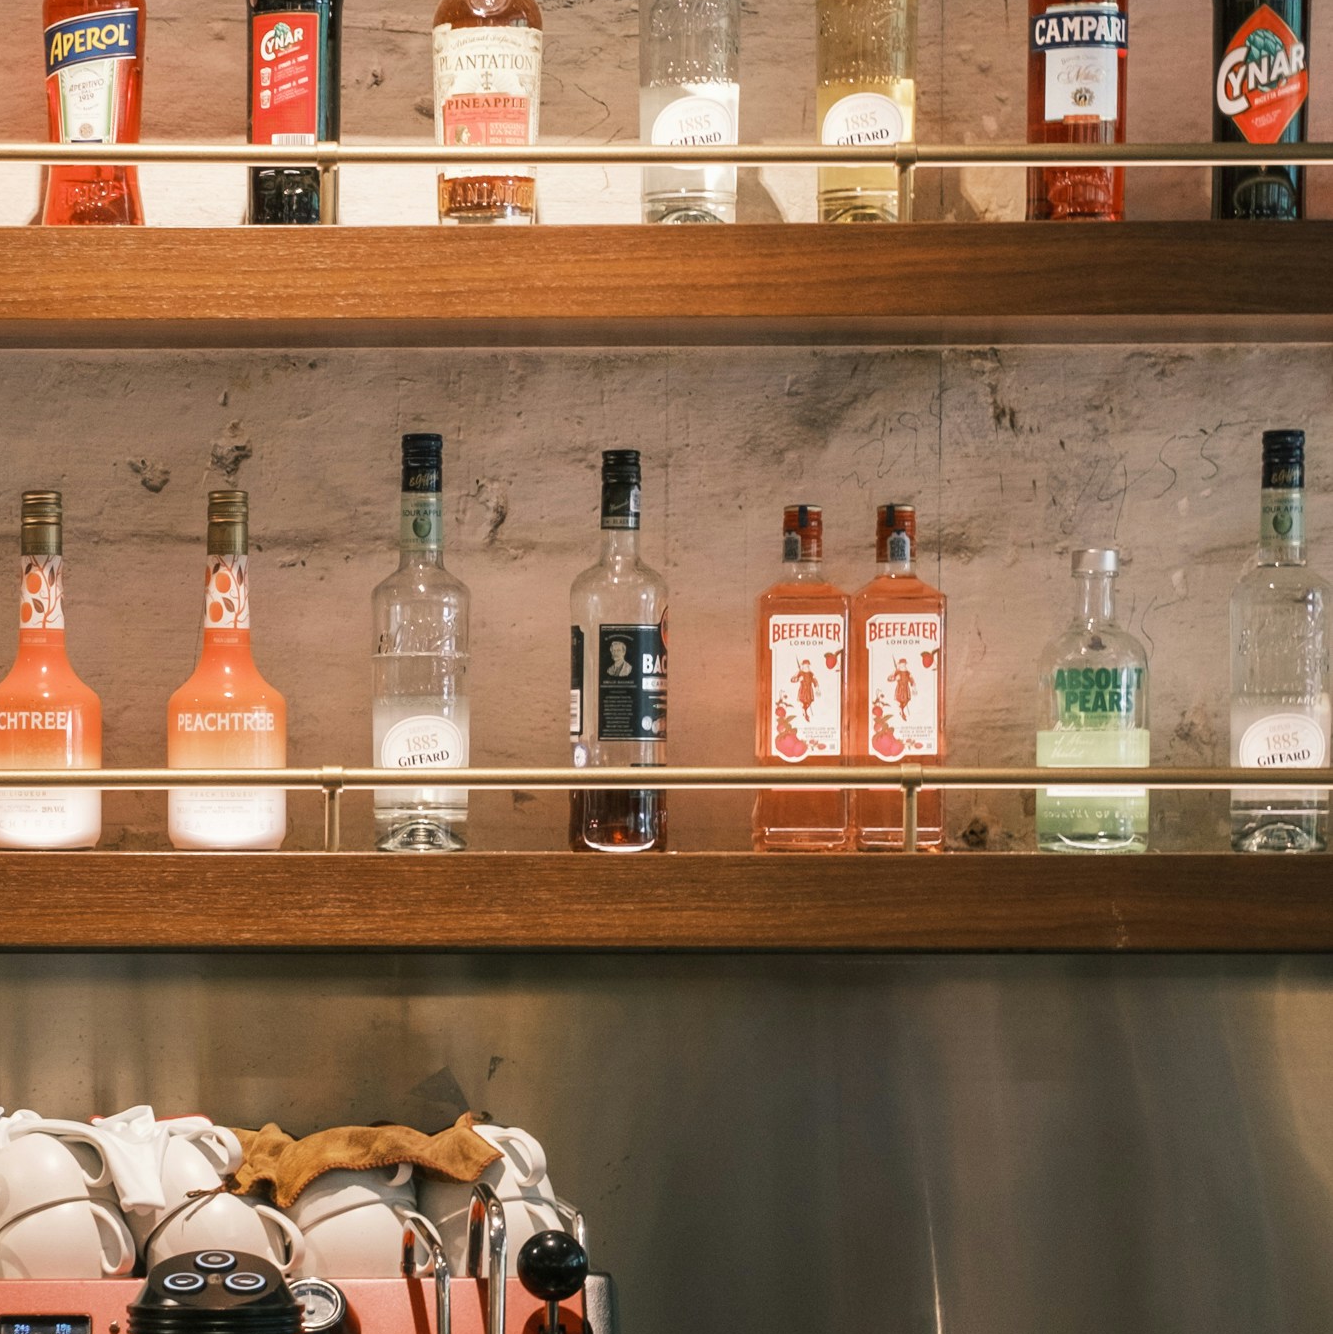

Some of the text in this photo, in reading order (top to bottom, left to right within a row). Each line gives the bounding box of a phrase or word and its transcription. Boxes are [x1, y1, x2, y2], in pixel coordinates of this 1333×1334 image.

[1035, 15, 1126, 46] CAMPARI
[50, 23, 129, 66] APEROL
[260, 27, 304, 61] CYNAR
[1216, 42, 1305, 116] CYNAR
[447, 97, 527, 110] PINEAPPLE
[844, 111, 879, 132] 1885
[837, 128, 890, 146] GIFFARD
[772, 623, 841, 644] BEEFEATER
[869, 622, 938, 643] BEEFEATER
[1065, 690, 1133, 713] PEARS
[177, 712, 275, 732] PEACHTREE
[406, 733, 439, 753] 1885
[1266, 731, 1299, 751] 1885
[398, 750, 450, 767] GIFFARD
[1257, 749, 1311, 767] GIFFARD
